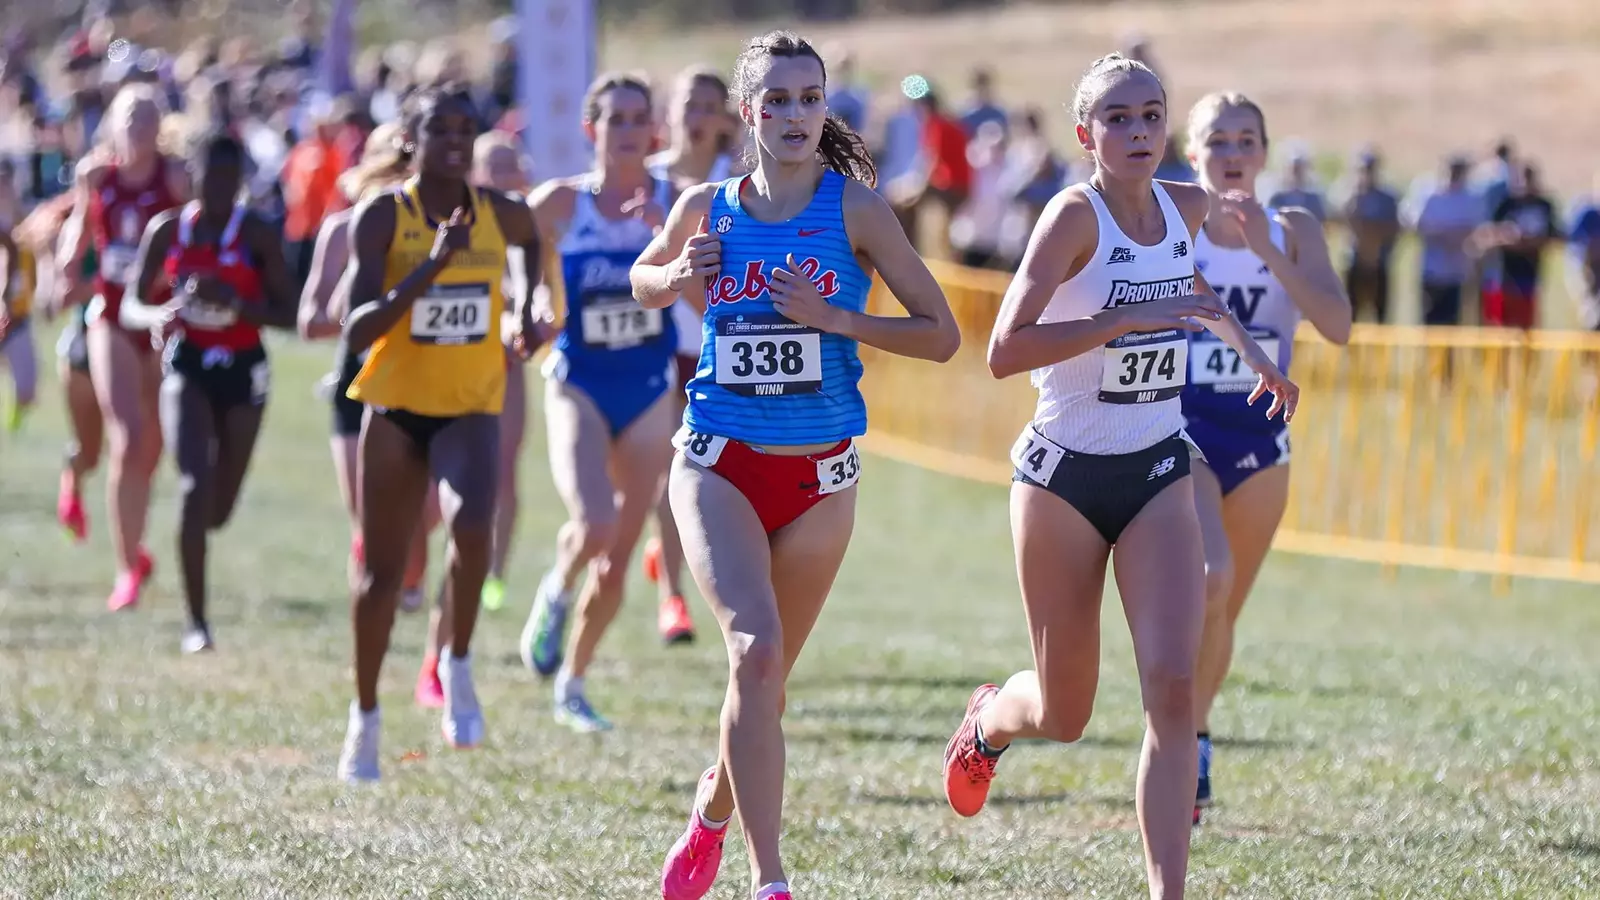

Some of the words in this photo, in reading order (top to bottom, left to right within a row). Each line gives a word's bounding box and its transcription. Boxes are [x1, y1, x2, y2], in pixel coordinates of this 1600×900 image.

[717, 215, 733, 233] SEC
[1109, 254, 1137, 262] EAST
[1112, 247, 1131, 255] BIG
[706, 257, 841, 306] Rebls
[427, 302, 478, 330] 240
[731, 340, 804, 377] 338
[1119, 347, 1175, 386] 374
[1206, 347, 1256, 375] 47
[755, 384, 785, 396] WINN
[1136, 390, 1158, 403] MAY
